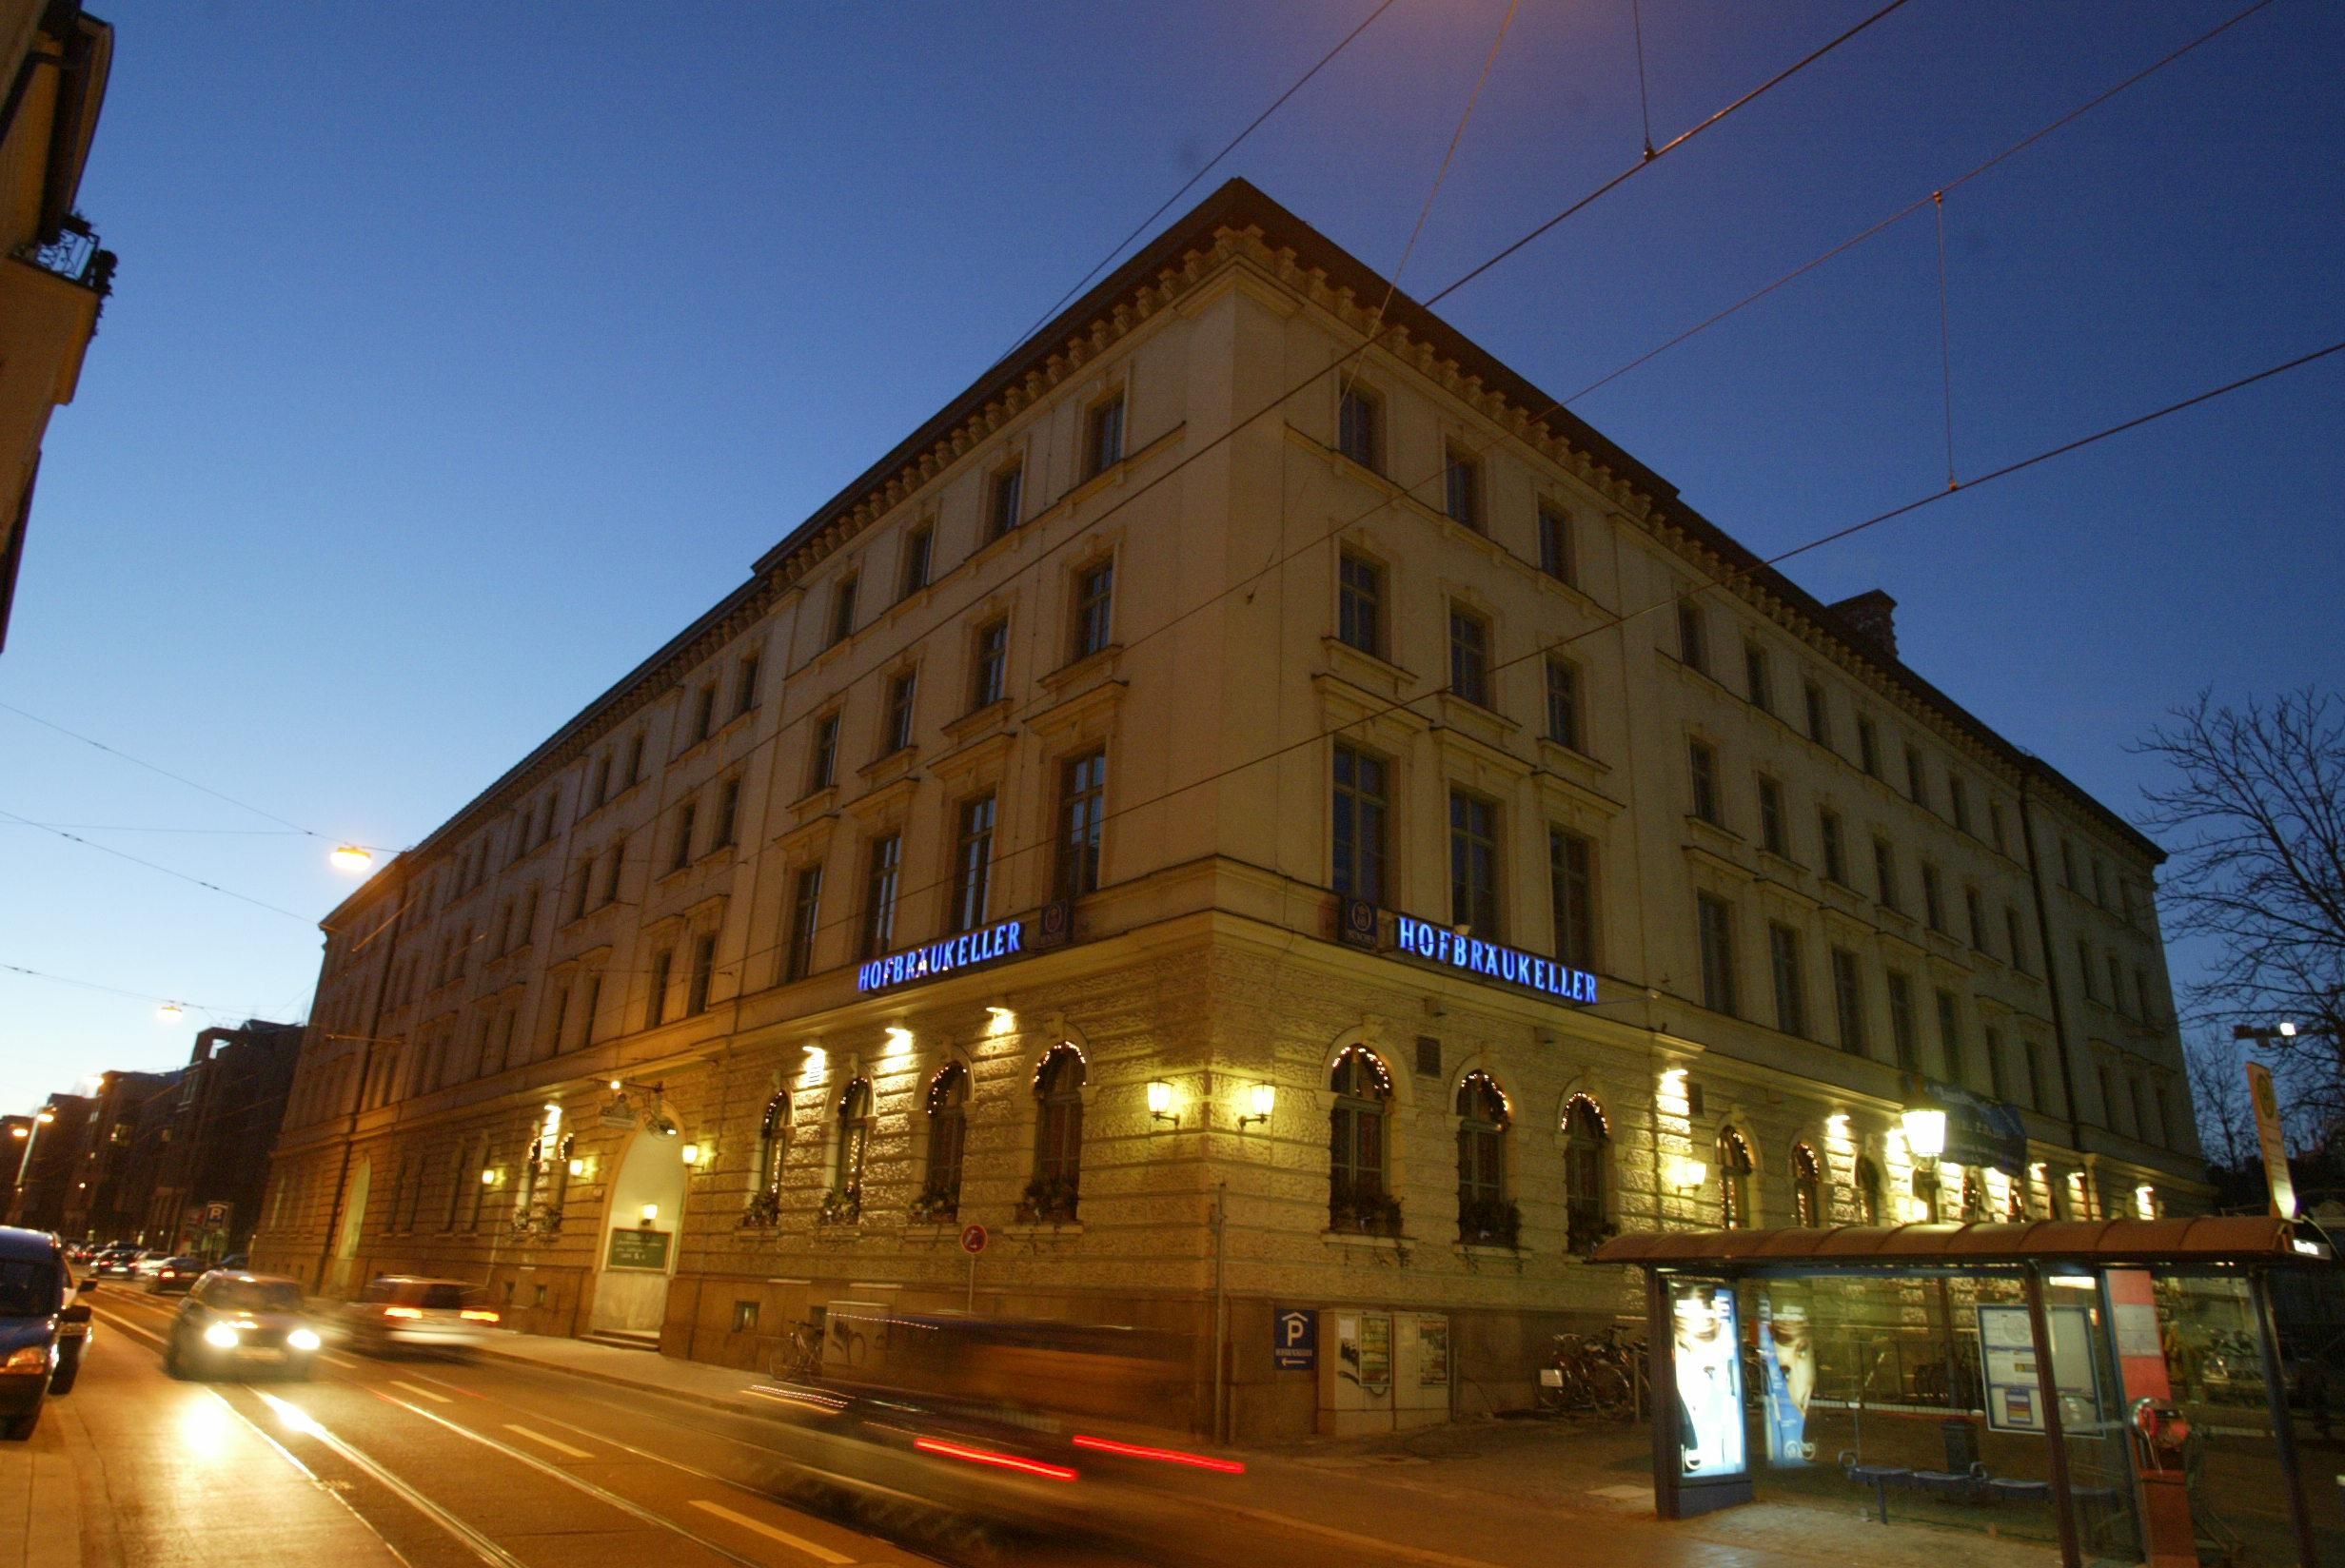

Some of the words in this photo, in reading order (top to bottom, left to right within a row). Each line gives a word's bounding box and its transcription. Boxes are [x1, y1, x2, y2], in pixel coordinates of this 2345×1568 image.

[857, 920, 1021, 991] HOFBRÄUKELLER
[1398, 915, 1598, 1005] HOFBRÄUKELLER
[1287, 1319, 1304, 1348] P
